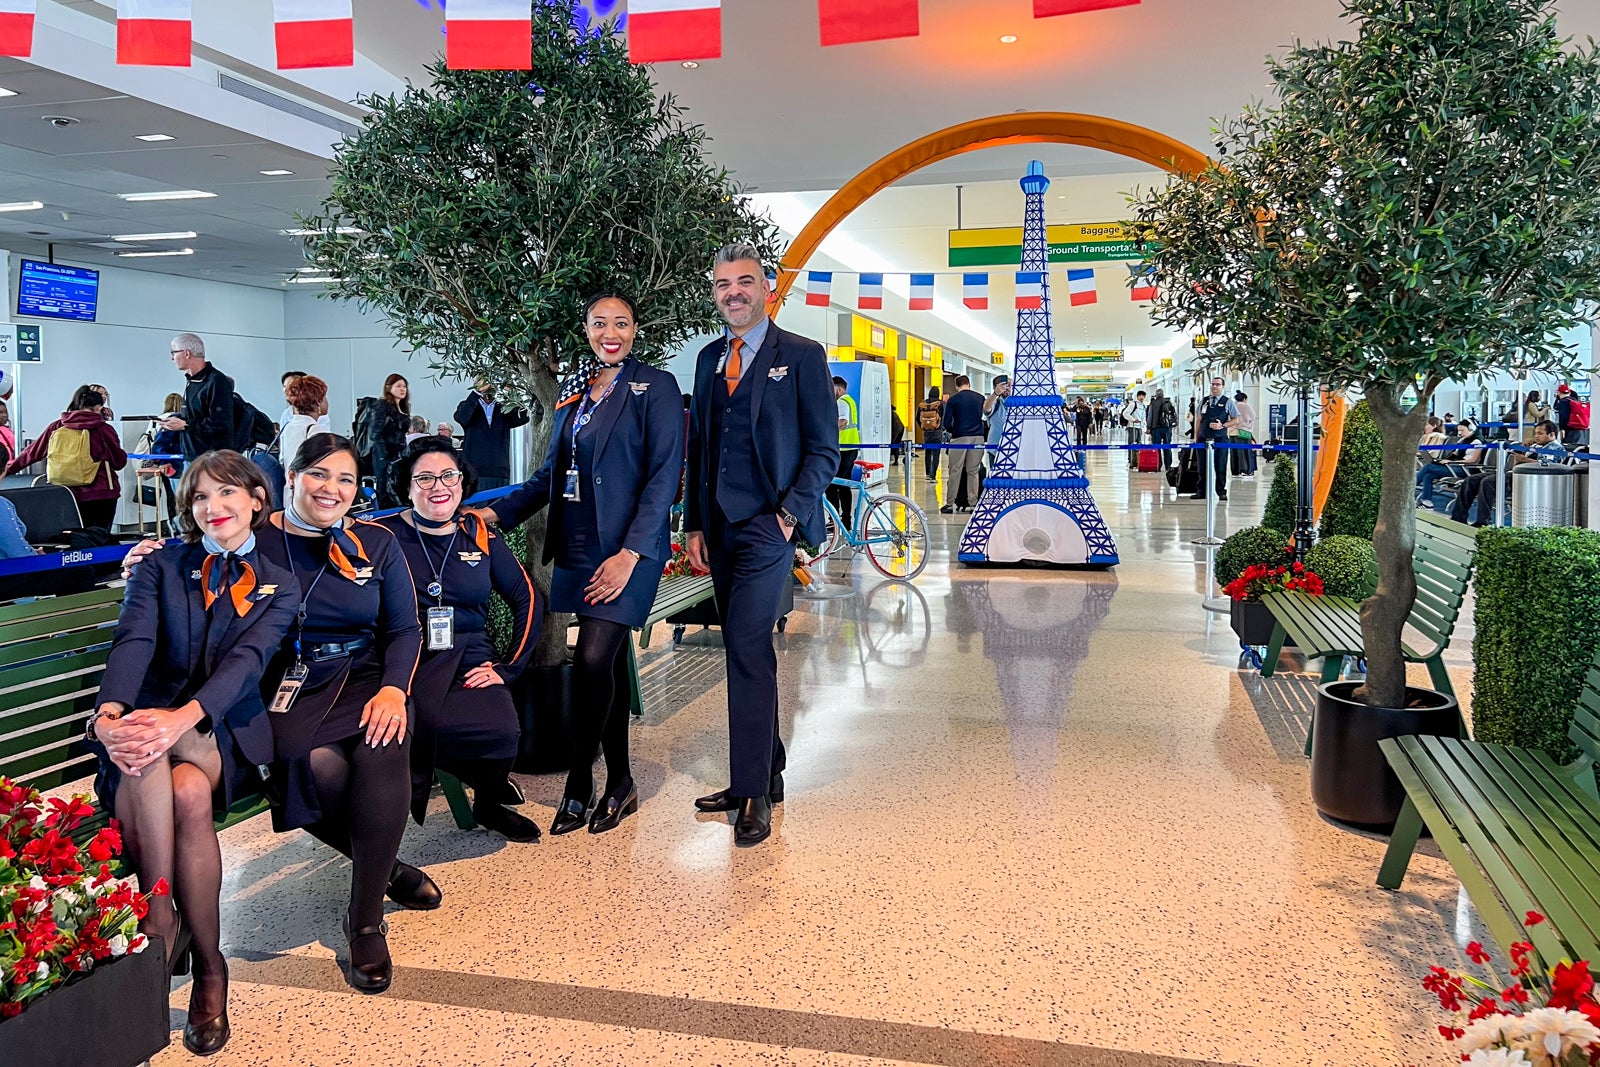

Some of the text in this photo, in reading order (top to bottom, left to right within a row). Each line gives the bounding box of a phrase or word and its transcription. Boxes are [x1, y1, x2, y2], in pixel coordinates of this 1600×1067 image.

[1080, 227, 1120, 236] Baggage
[1047, 245, 1079, 255] Ground
[62, 551, 93, 566] jetBlue
